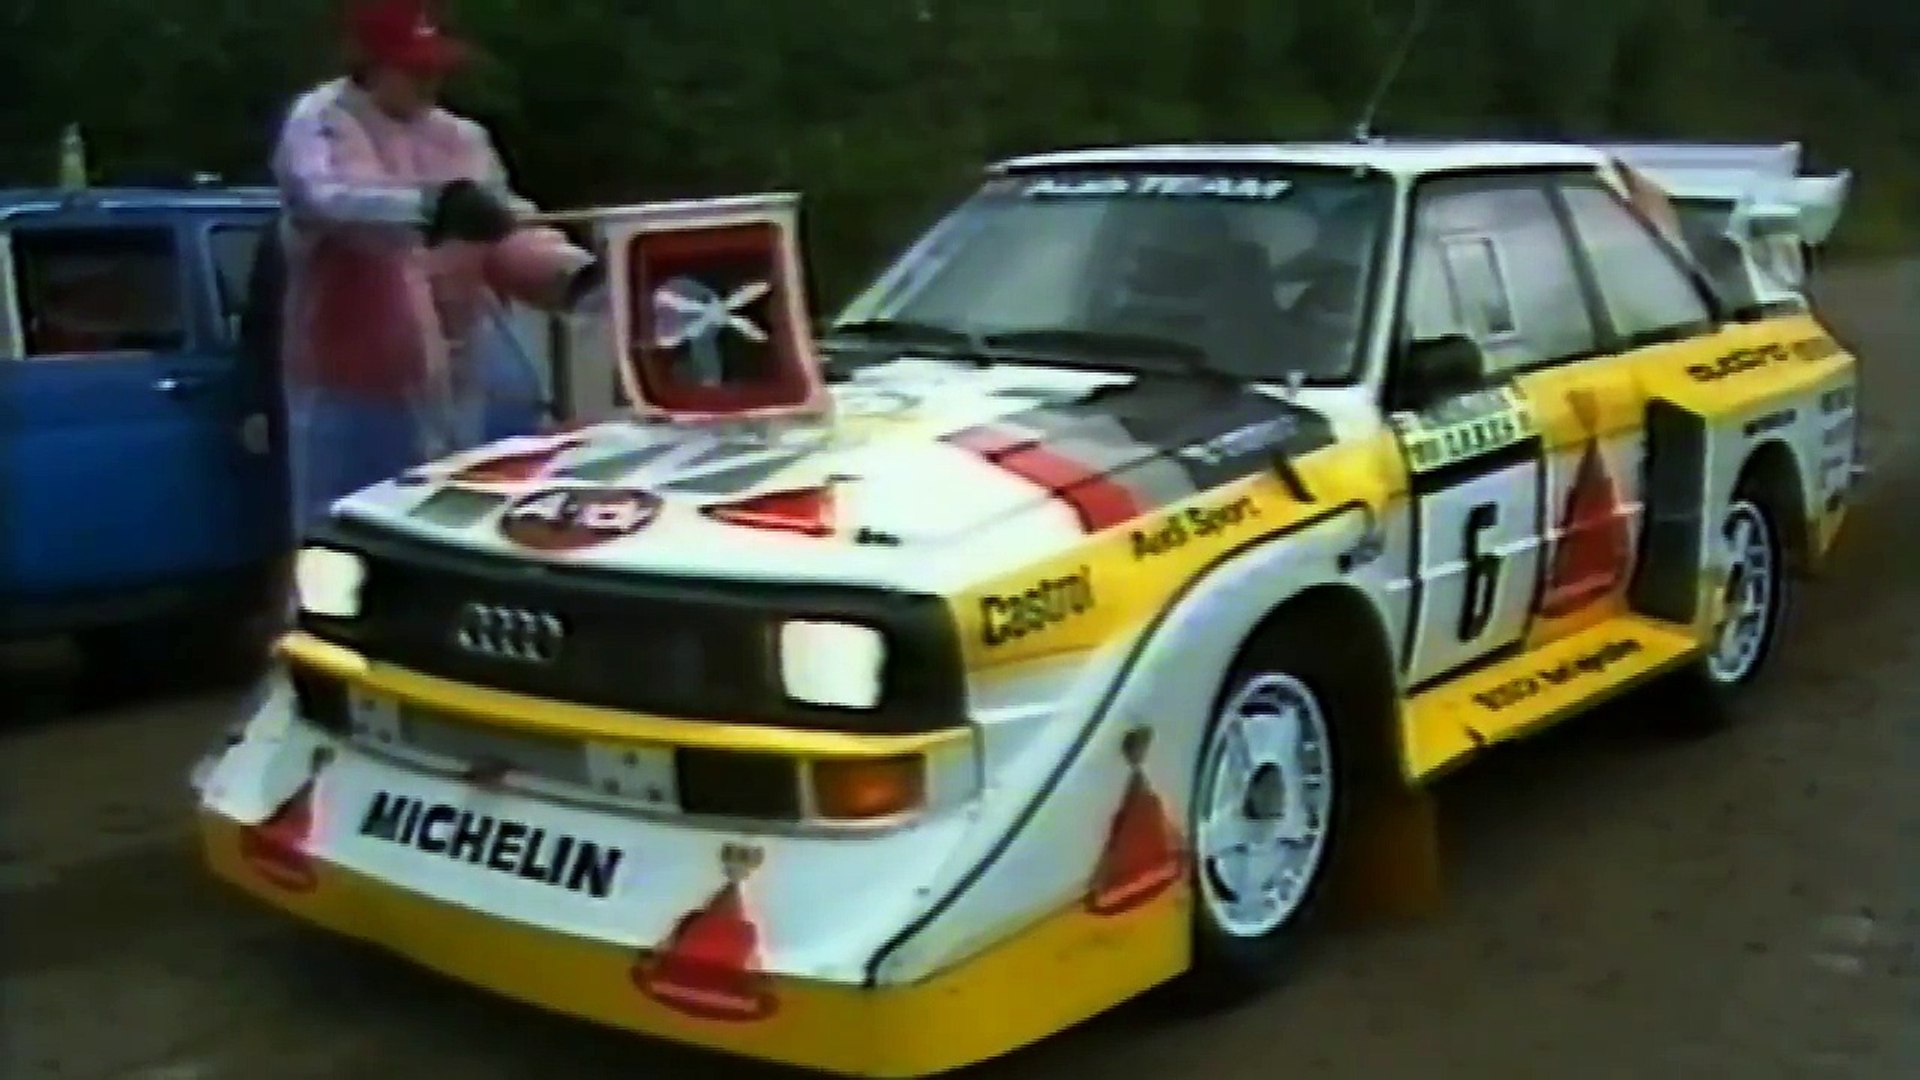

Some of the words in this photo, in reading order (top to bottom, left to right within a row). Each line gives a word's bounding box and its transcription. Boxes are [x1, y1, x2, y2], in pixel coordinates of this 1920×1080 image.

[1130, 516, 1187, 561] Audi
[1188, 495, 1262, 540] Sport
[1457, 501, 1506, 644] 6
[981, 565, 1092, 647] Castrol
[360, 791, 623, 899] MICHELIN
